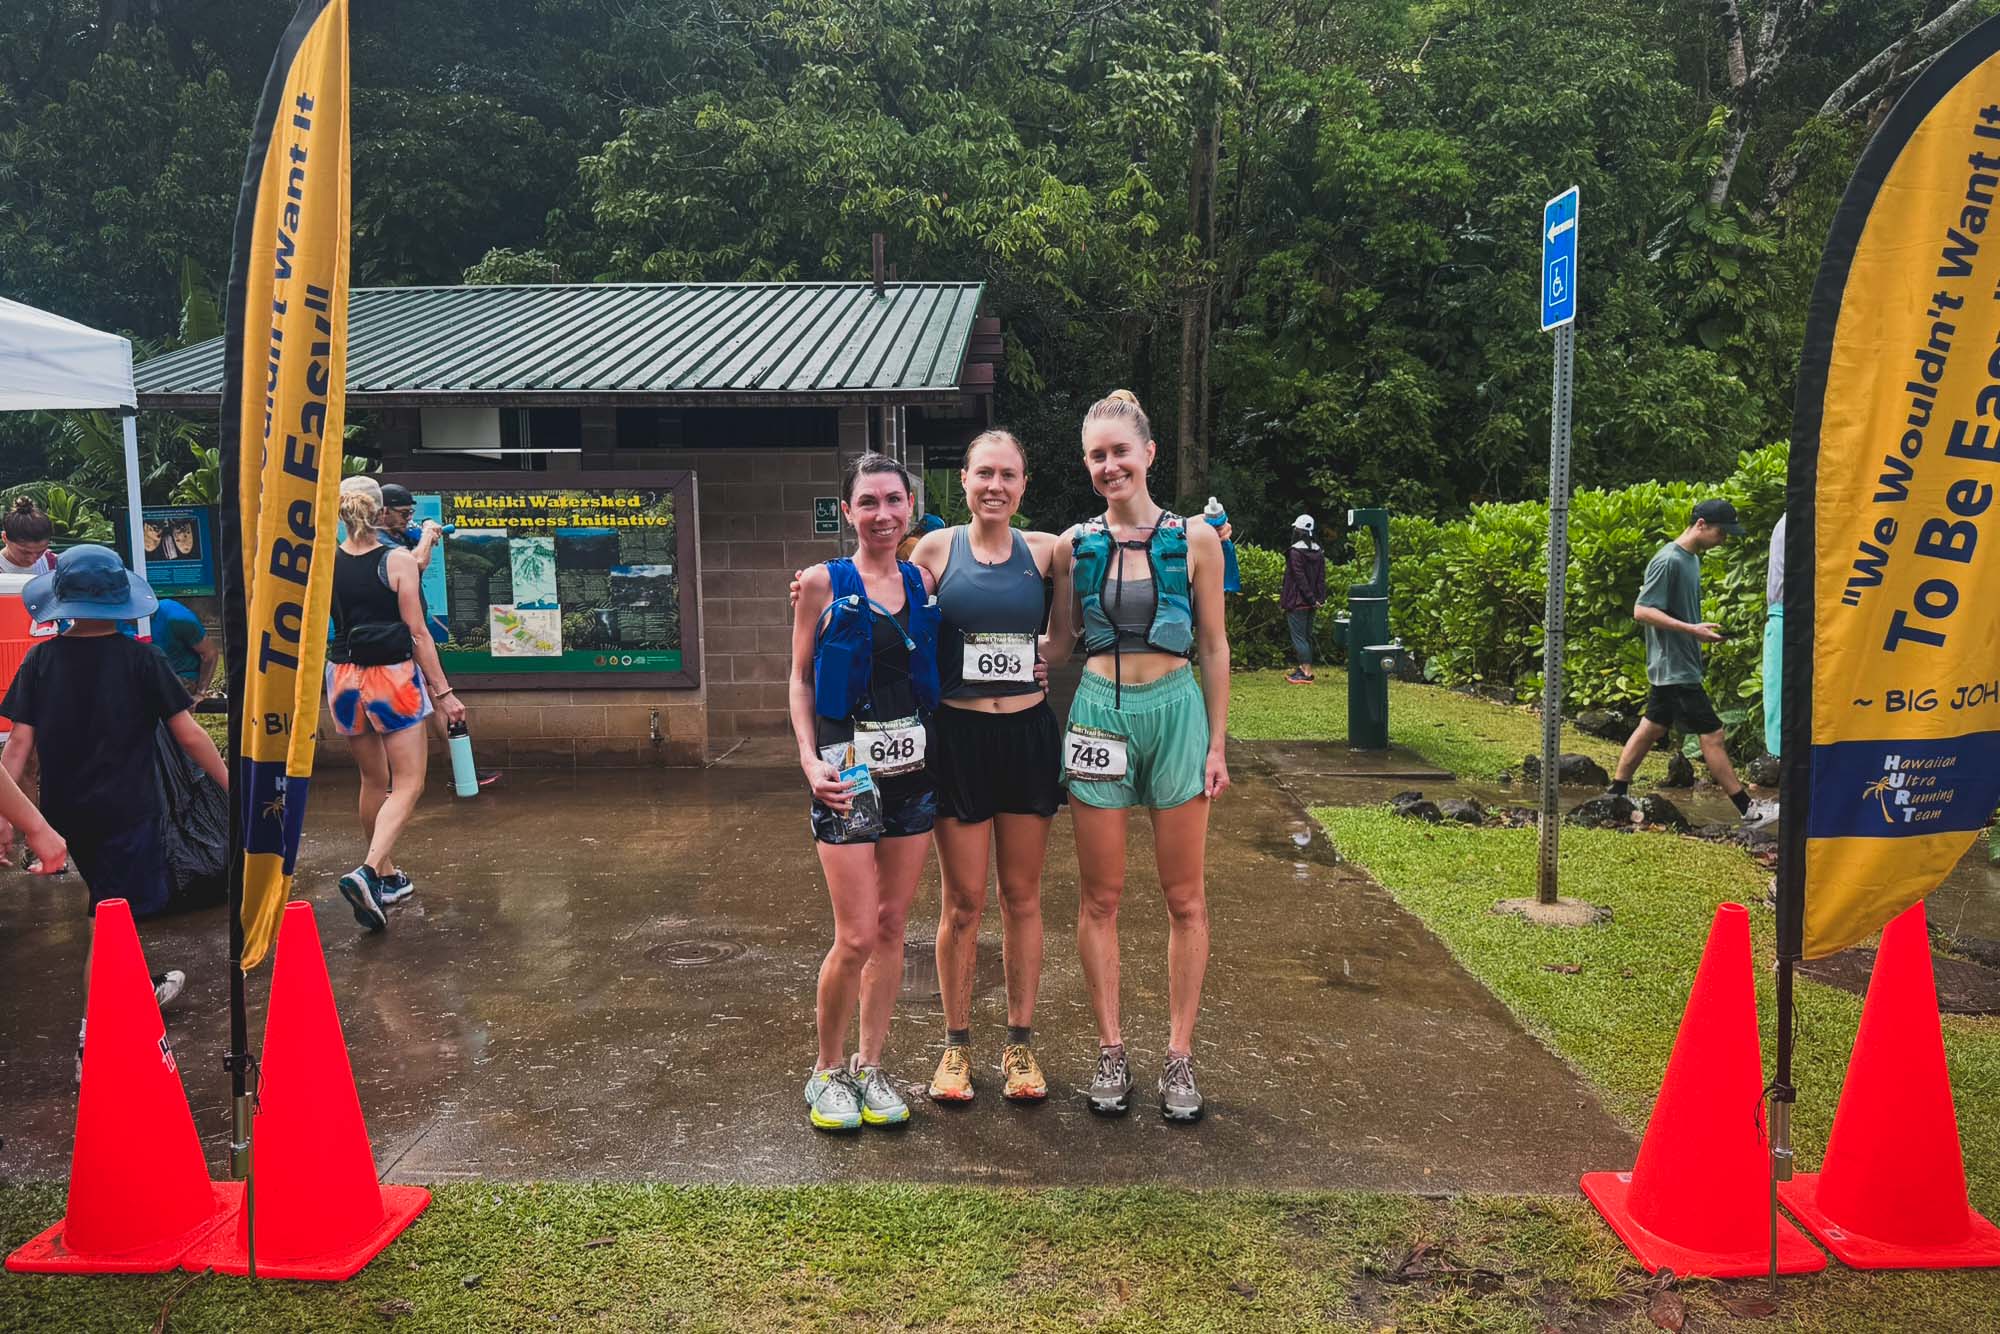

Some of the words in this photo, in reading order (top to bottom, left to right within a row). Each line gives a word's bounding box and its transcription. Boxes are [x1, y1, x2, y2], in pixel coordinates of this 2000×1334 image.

[274, 143, 308, 279] Want
[1841, 517, 1898, 607] "We
[1872, 291, 1965, 503] Wouldn't
[1936, 151, 2000, 277] Want
[453, 495, 526, 508] Makiki
[528, 495, 641, 508] Watershed
[454, 514, 567, 527] Awareness
[572, 513, 668, 527] Initiative
[1913, 479, 1993, 564] Be
[268, 500, 317, 588] Be
[1882, 578, 1960, 652] To
[259, 600, 304, 674] To
[978, 653, 1021, 674] 693
[1885, 688, 1938, 713] BIG
[264, 712, 293, 735] BI
[870, 738, 914, 761] 648
[1071, 743, 1110, 768] 748
[1884, 755, 1957, 770] Hawaiian
[1889, 772, 1937, 788] Ultra
[1894, 788, 1954, 805] Running
[1903, 807, 1942, 823] Team
